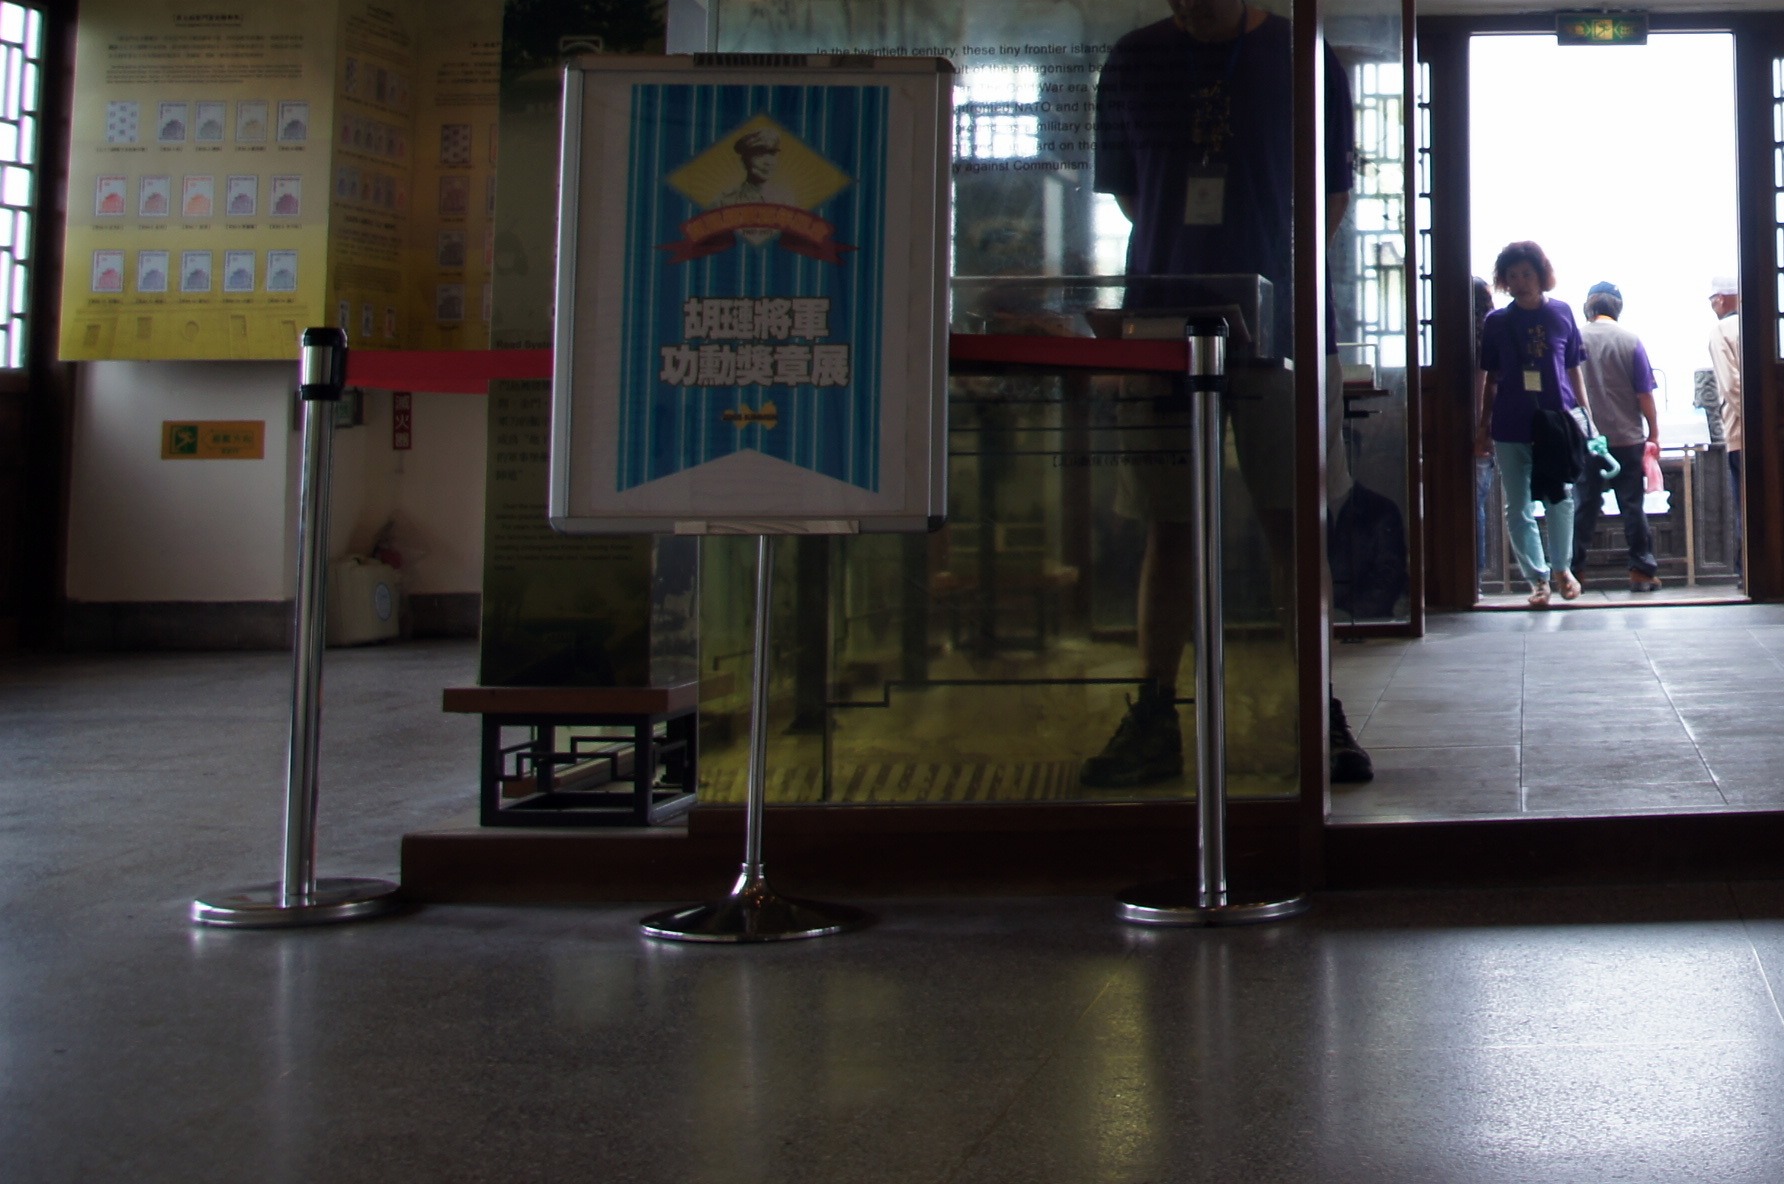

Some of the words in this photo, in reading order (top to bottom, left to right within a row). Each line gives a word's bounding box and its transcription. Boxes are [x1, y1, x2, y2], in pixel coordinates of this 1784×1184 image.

[912, 46, 959, 58] century,
[963, 45, 995, 55] these
[999, 44, 1020, 57] tiny
[1024, 43, 1067, 55] frontier
[1070, 43, 1112, 55] islands
[1040, 83, 1064, 94] War
[1067, 84, 1088, 94] era
[1014, 102, 1051, 113] NATO
[1055, 102, 1079, 113] and
[1059, 141, 1074, 151] on
[965, 161, 1009, 174] against
[1012, 159, 1089, 171] Communism.
